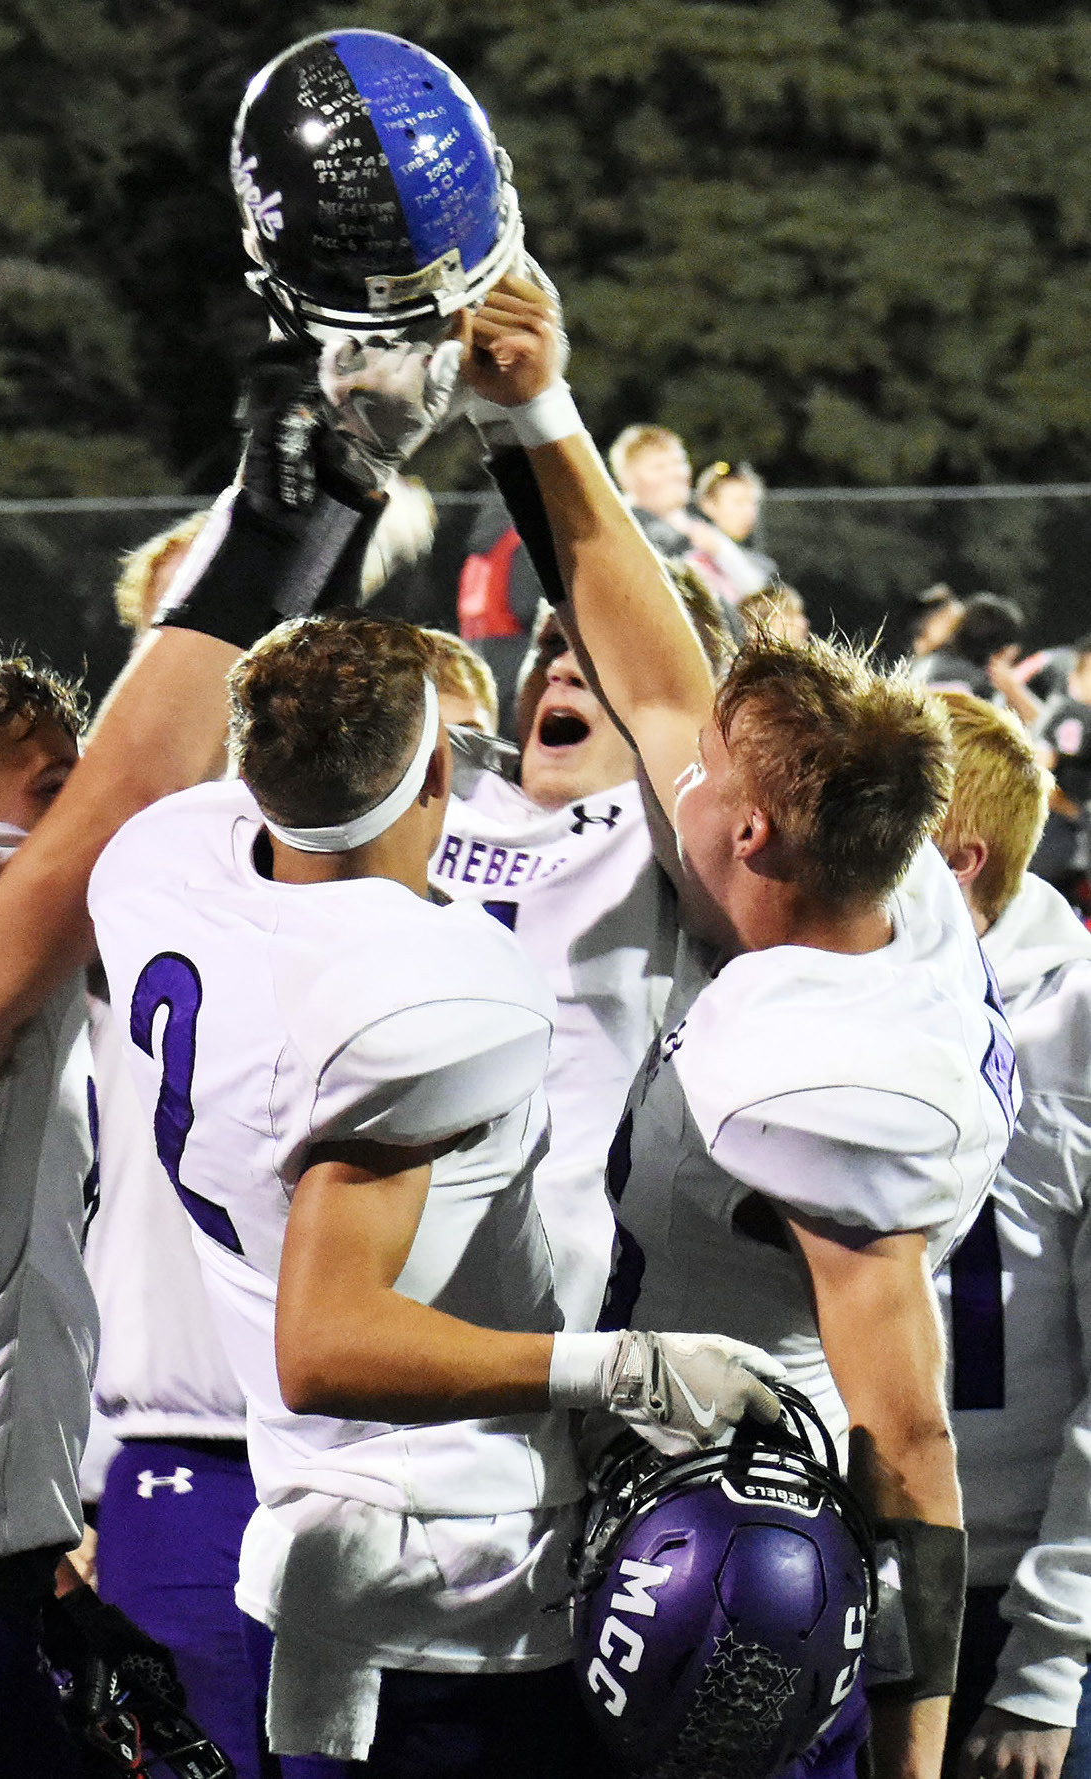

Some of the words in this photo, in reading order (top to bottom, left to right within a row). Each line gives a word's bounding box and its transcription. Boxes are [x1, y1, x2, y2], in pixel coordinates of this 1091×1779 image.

[436, 834, 567, 886] REBELS
[129, 951, 245, 1256] 2
[744, 1485, 809, 1507] REBELS
[587, 1559, 673, 1717] MCC
